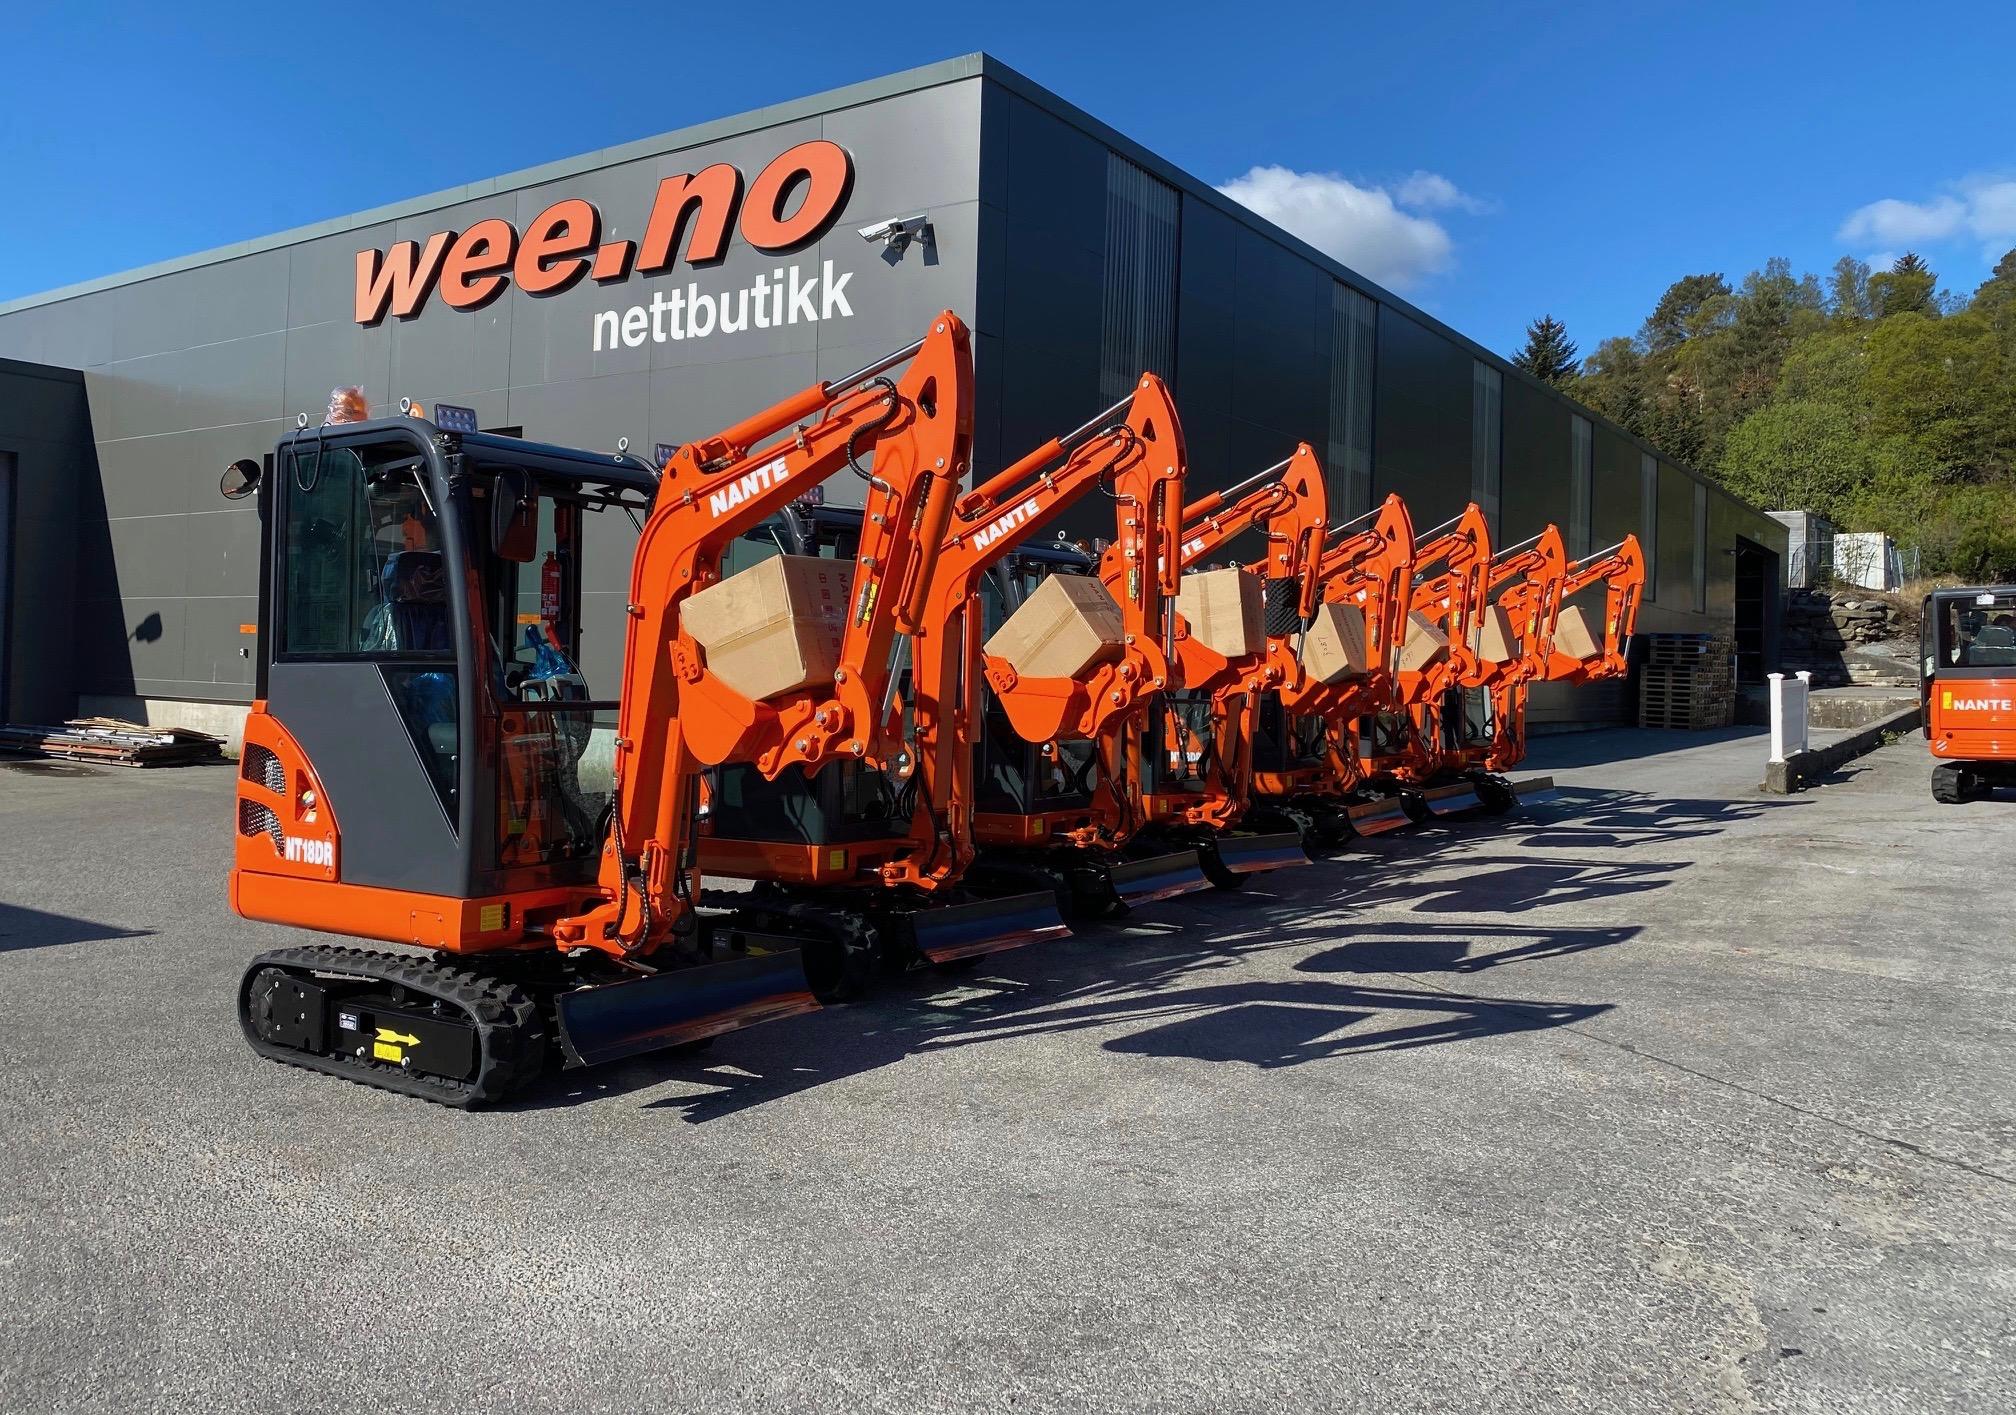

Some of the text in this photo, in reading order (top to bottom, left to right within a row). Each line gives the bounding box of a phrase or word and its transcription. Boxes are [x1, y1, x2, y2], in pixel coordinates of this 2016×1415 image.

[354, 140, 853, 326] wee.no
[593, 260, 855, 352] nettbutikk
[709, 456, 789, 519] NANTE
[972, 497, 1040, 552] NANTE
[1953, 699, 2012, 711] NANTE
[285, 836, 333, 867] NT18DR
